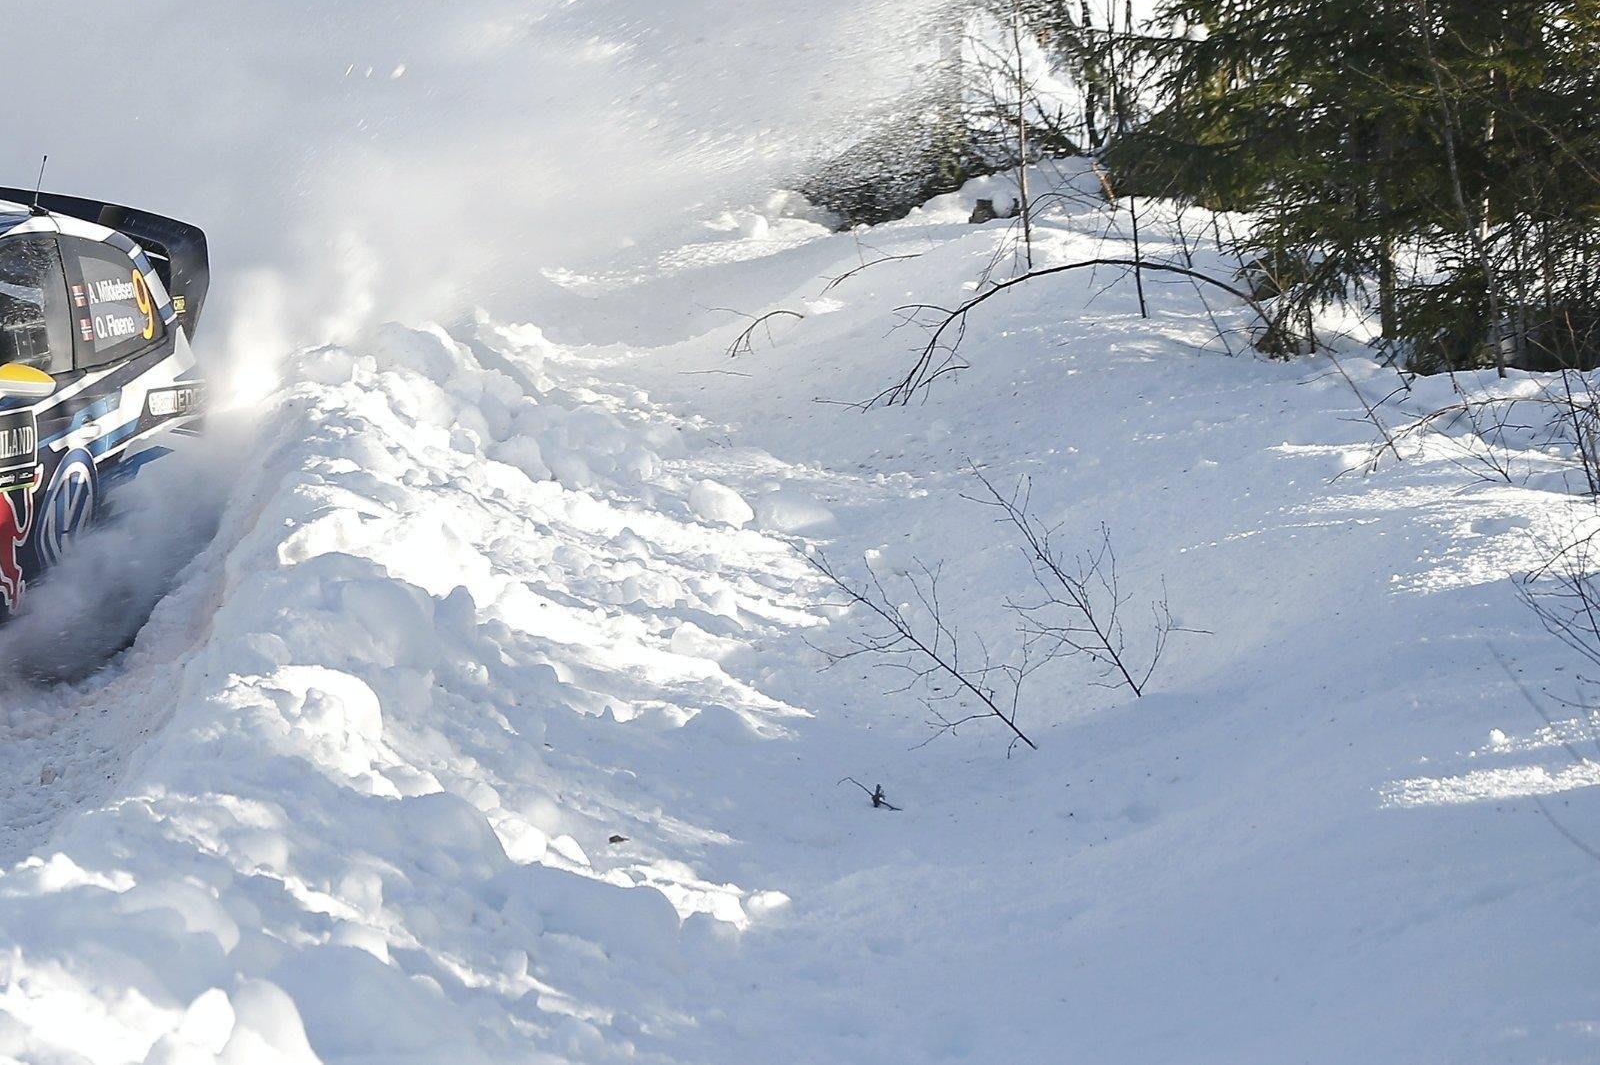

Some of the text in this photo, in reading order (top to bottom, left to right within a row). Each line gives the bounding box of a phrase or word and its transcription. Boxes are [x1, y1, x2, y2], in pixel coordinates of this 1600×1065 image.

[87, 278, 136, 305] A. Mikkelsen
[131, 268, 154, 340] 9
[95, 316, 108, 339] O.
